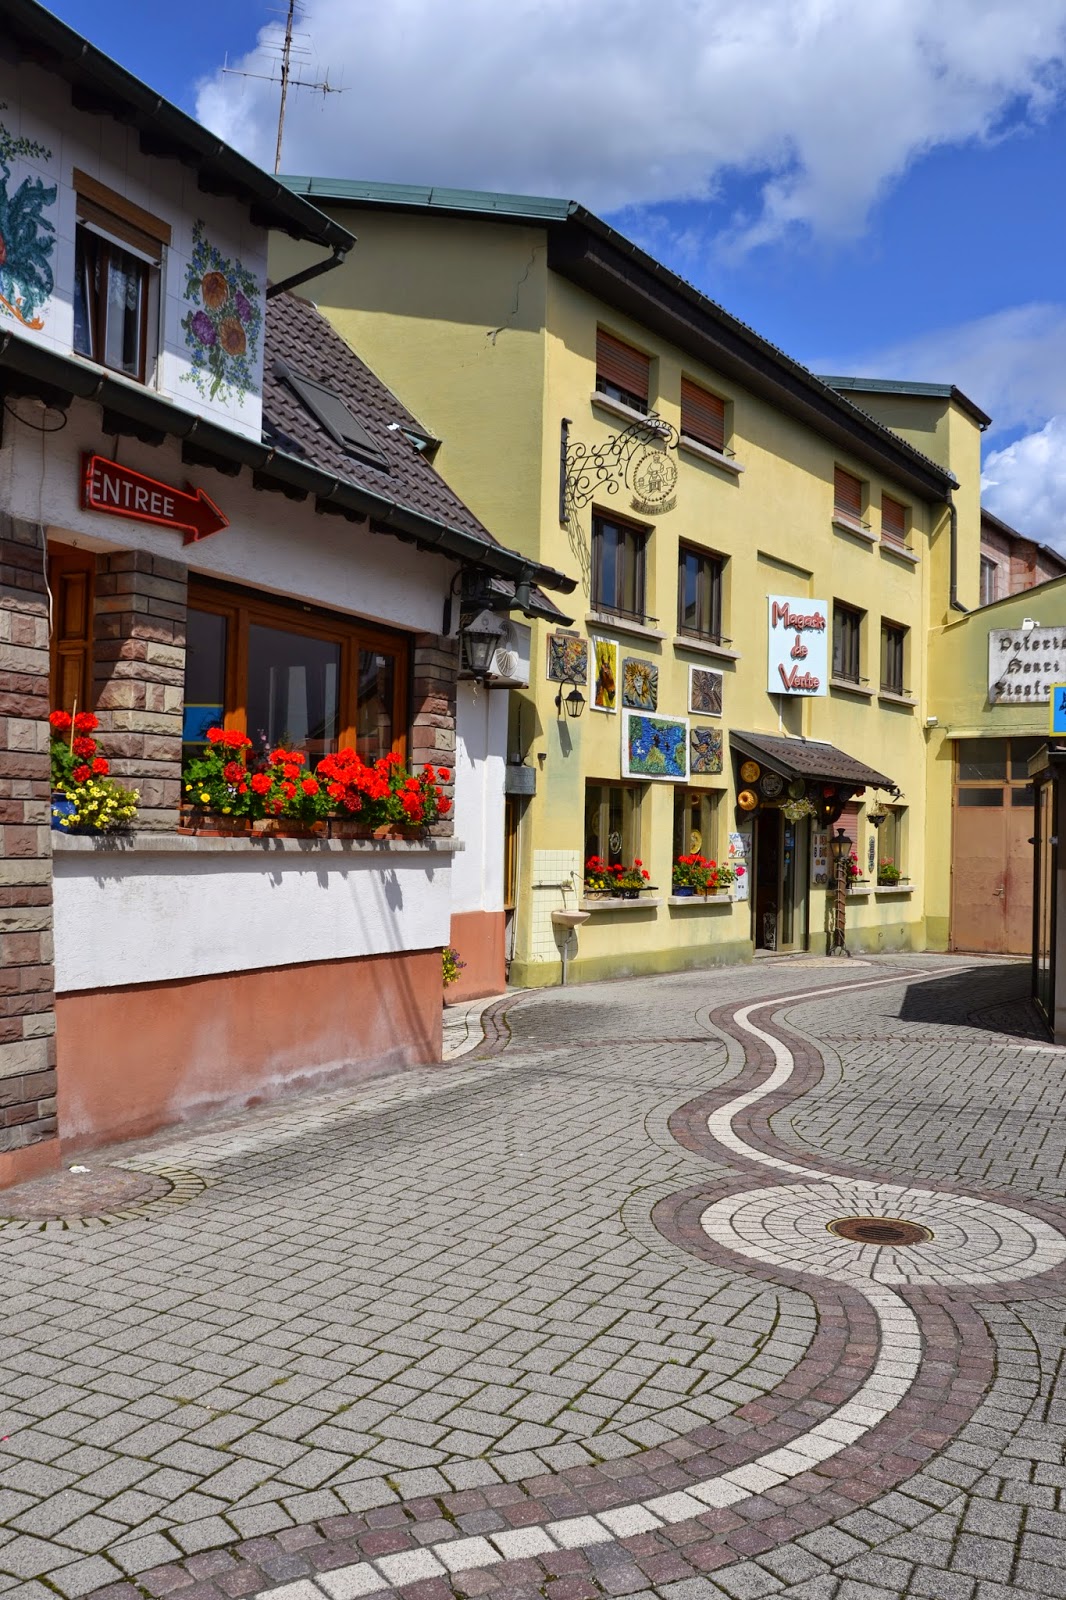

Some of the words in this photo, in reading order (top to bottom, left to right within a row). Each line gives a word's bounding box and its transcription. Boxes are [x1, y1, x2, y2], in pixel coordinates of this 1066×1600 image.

[91, 468, 176, 518] ENTREE
[791, 634, 808, 658] de
[778, 663, 820, 692] Vente
[1007, 658, 1060, 674] Henri
[995, 680, 1050, 696] Siegfr
